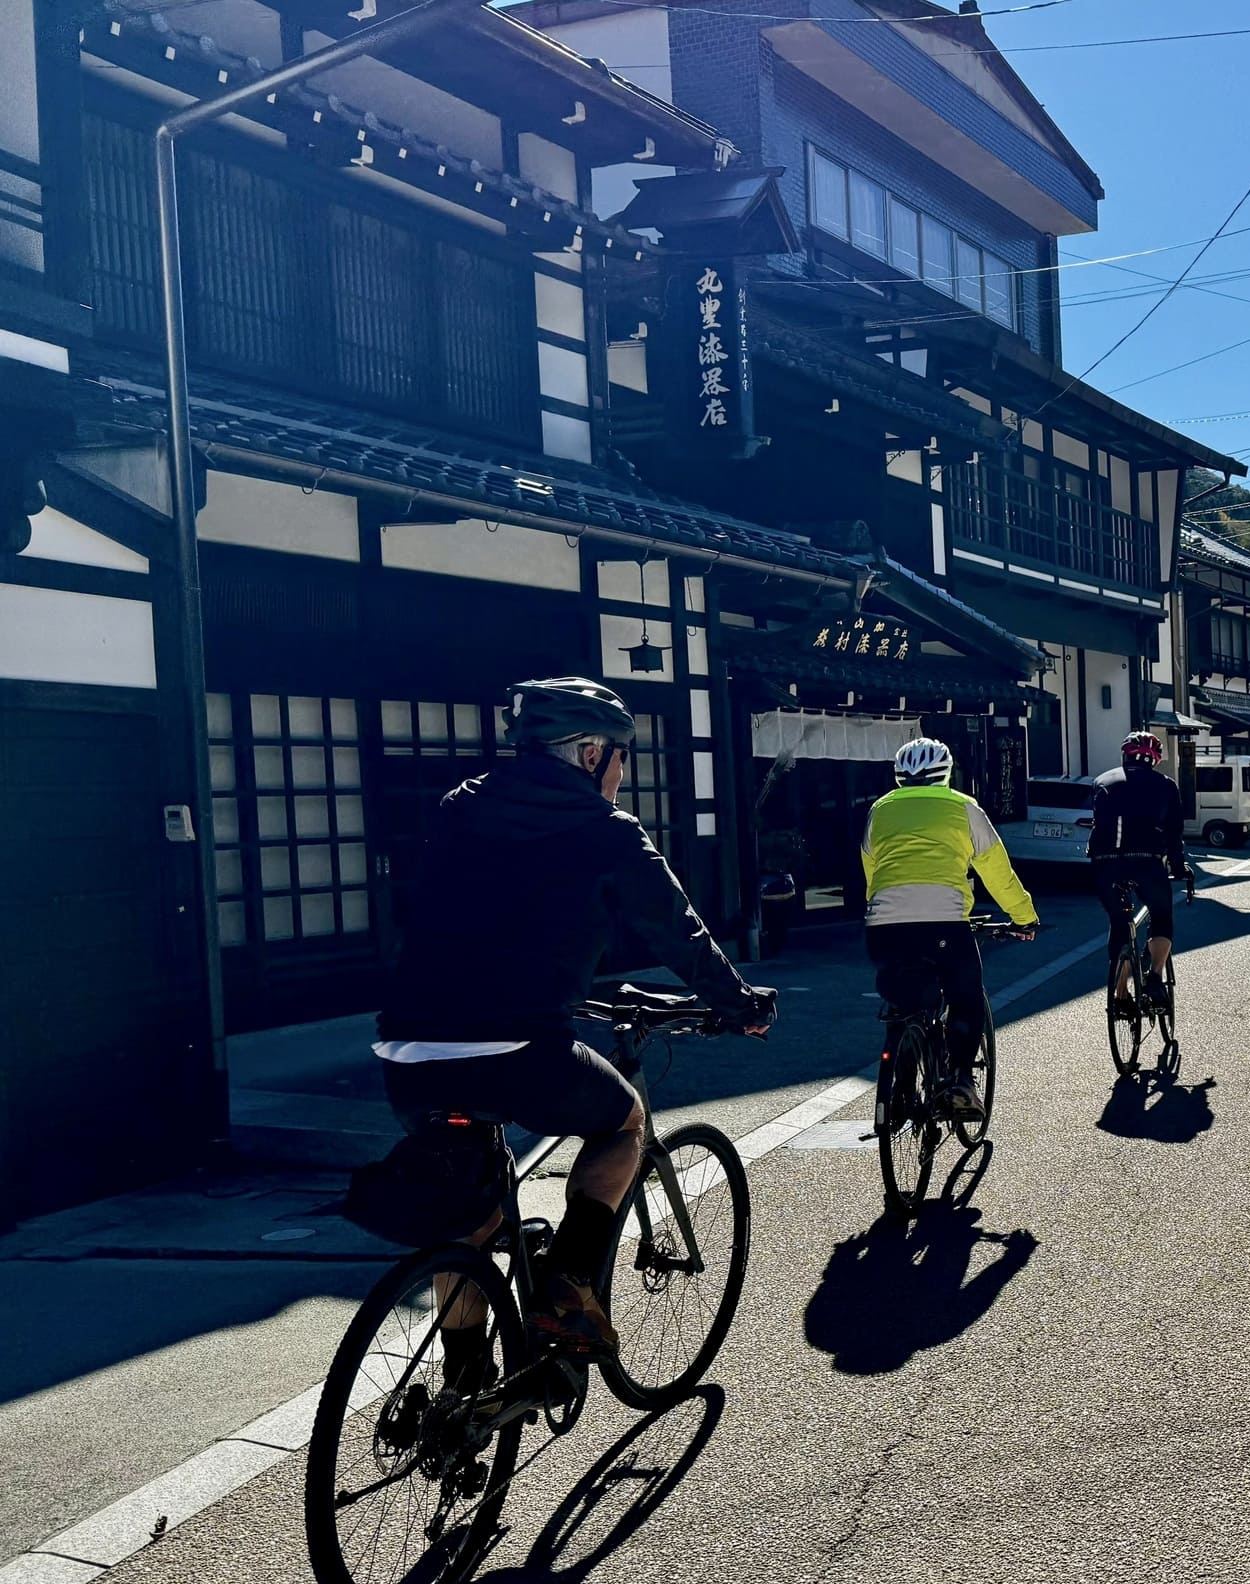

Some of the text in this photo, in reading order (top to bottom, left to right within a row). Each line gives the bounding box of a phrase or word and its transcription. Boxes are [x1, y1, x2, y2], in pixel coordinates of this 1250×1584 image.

[695, 267, 730, 427] 丸豊漆器店
